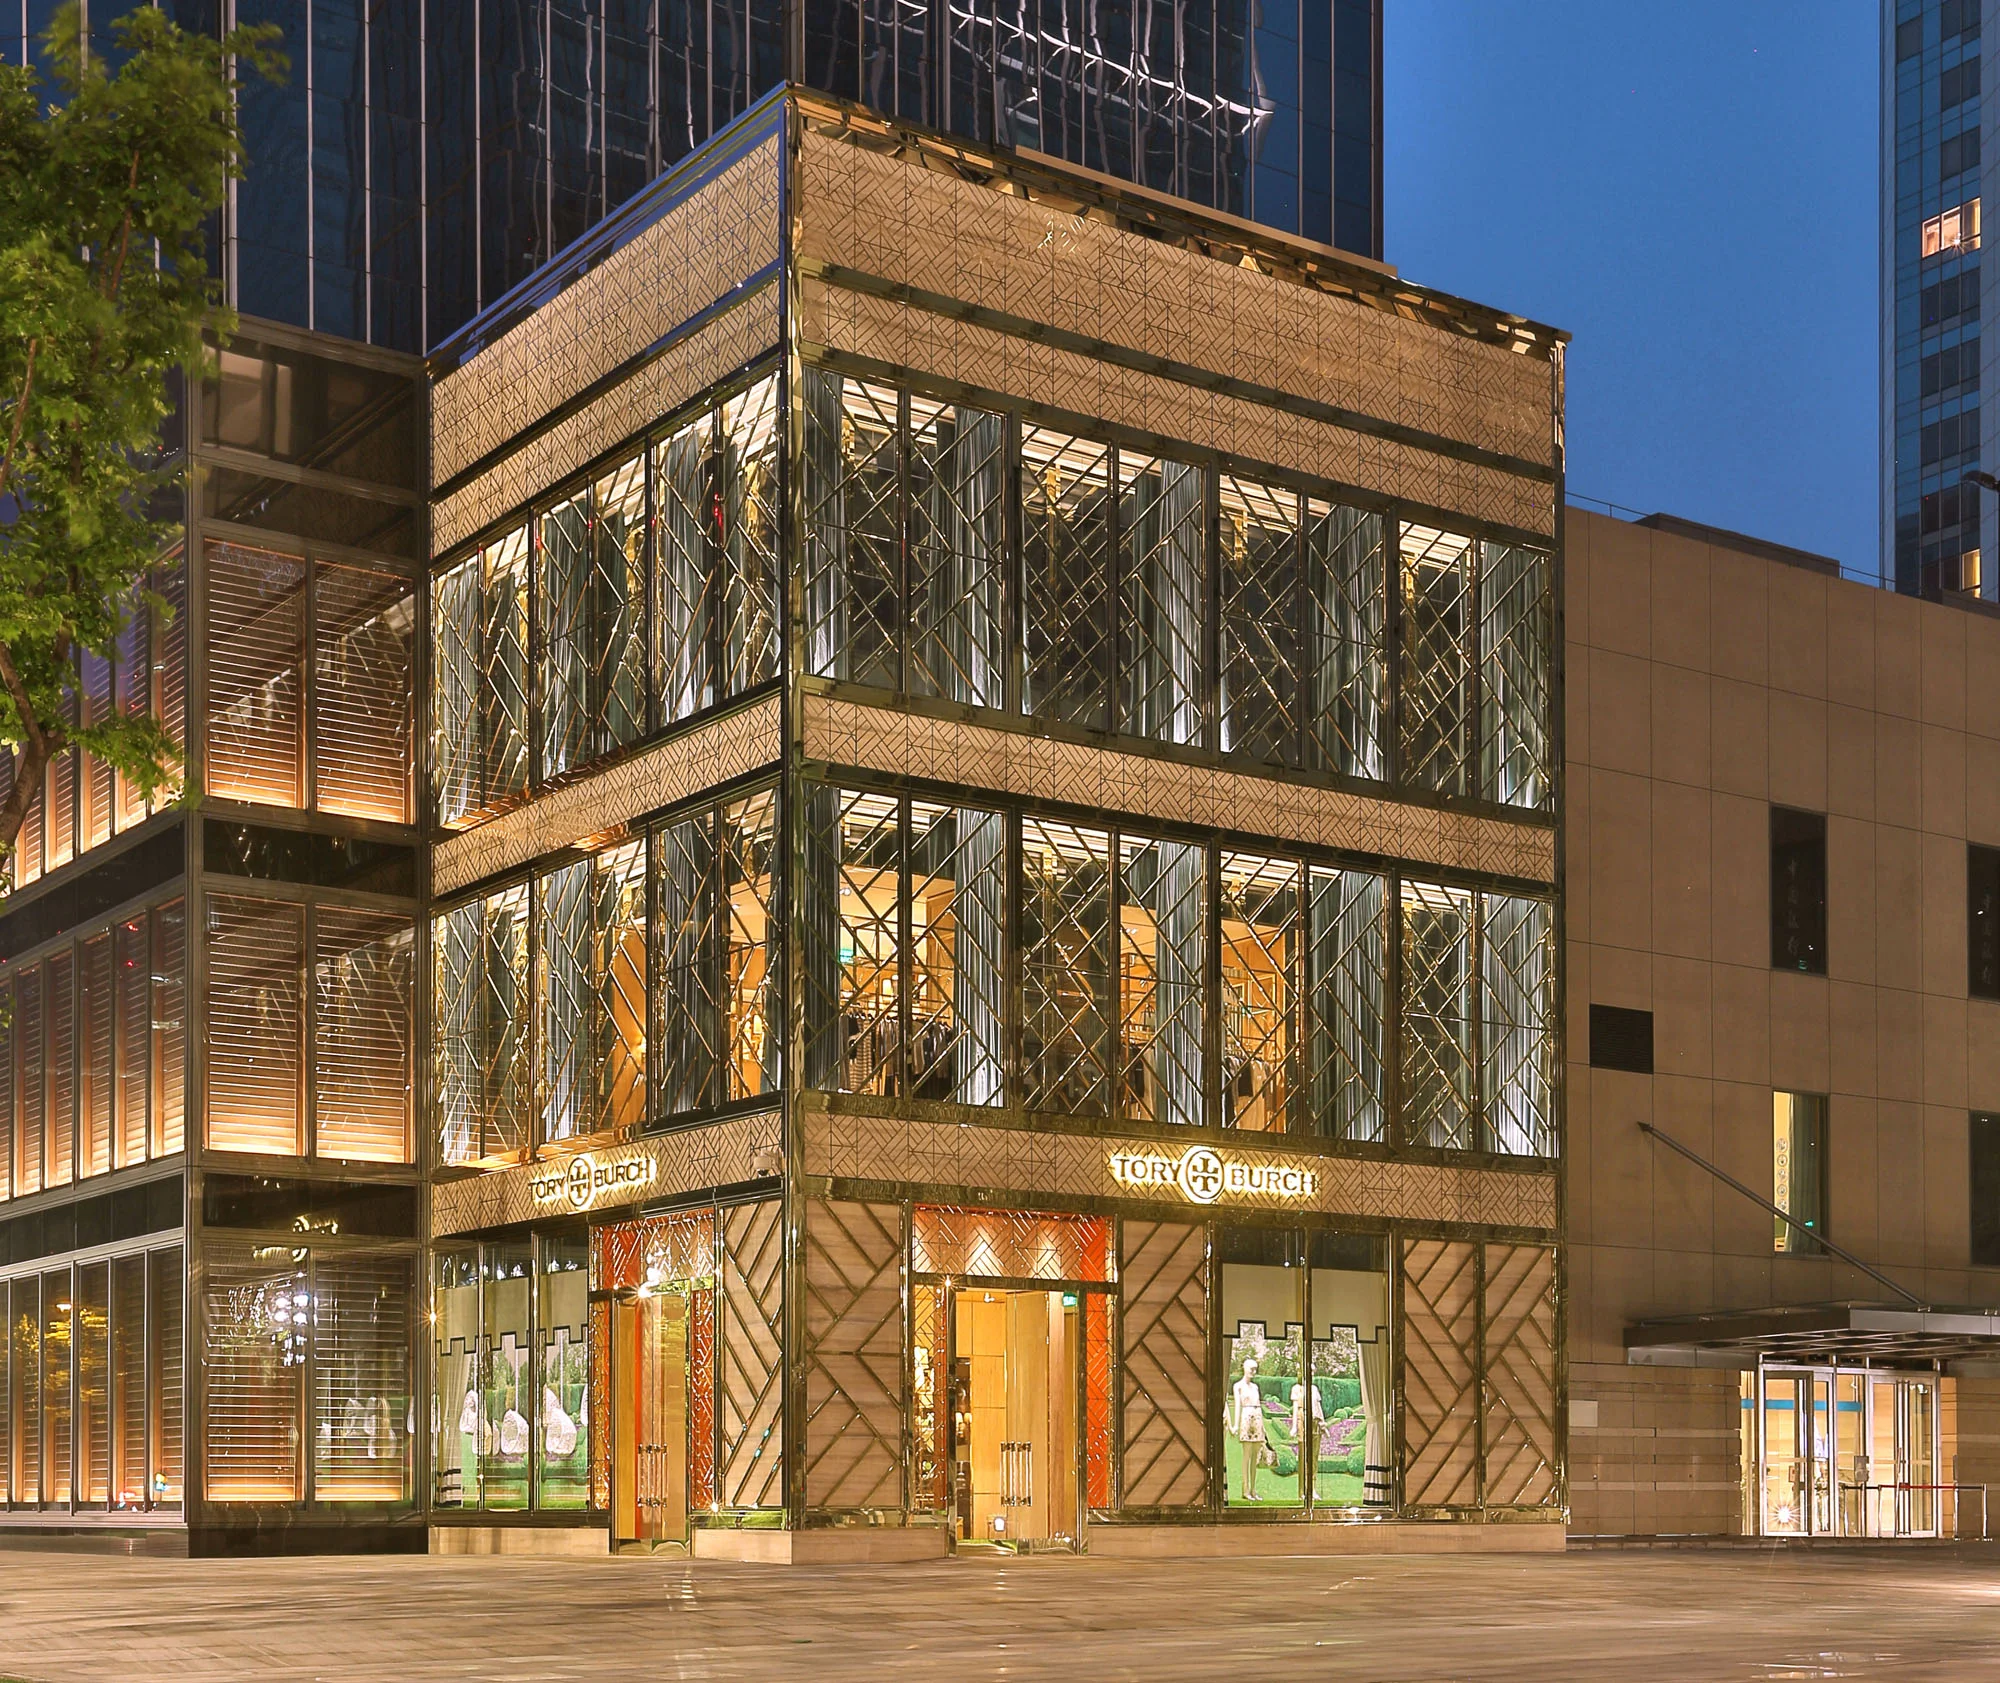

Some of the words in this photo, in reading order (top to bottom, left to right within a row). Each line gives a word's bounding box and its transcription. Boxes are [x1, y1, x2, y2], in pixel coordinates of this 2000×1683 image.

[528, 1176, 566, 1201] TORY
[594, 1159, 651, 1188] BURCH
[1116, 1157, 1181, 1181] TORY
[1231, 1168, 1316, 1193] BURCH
